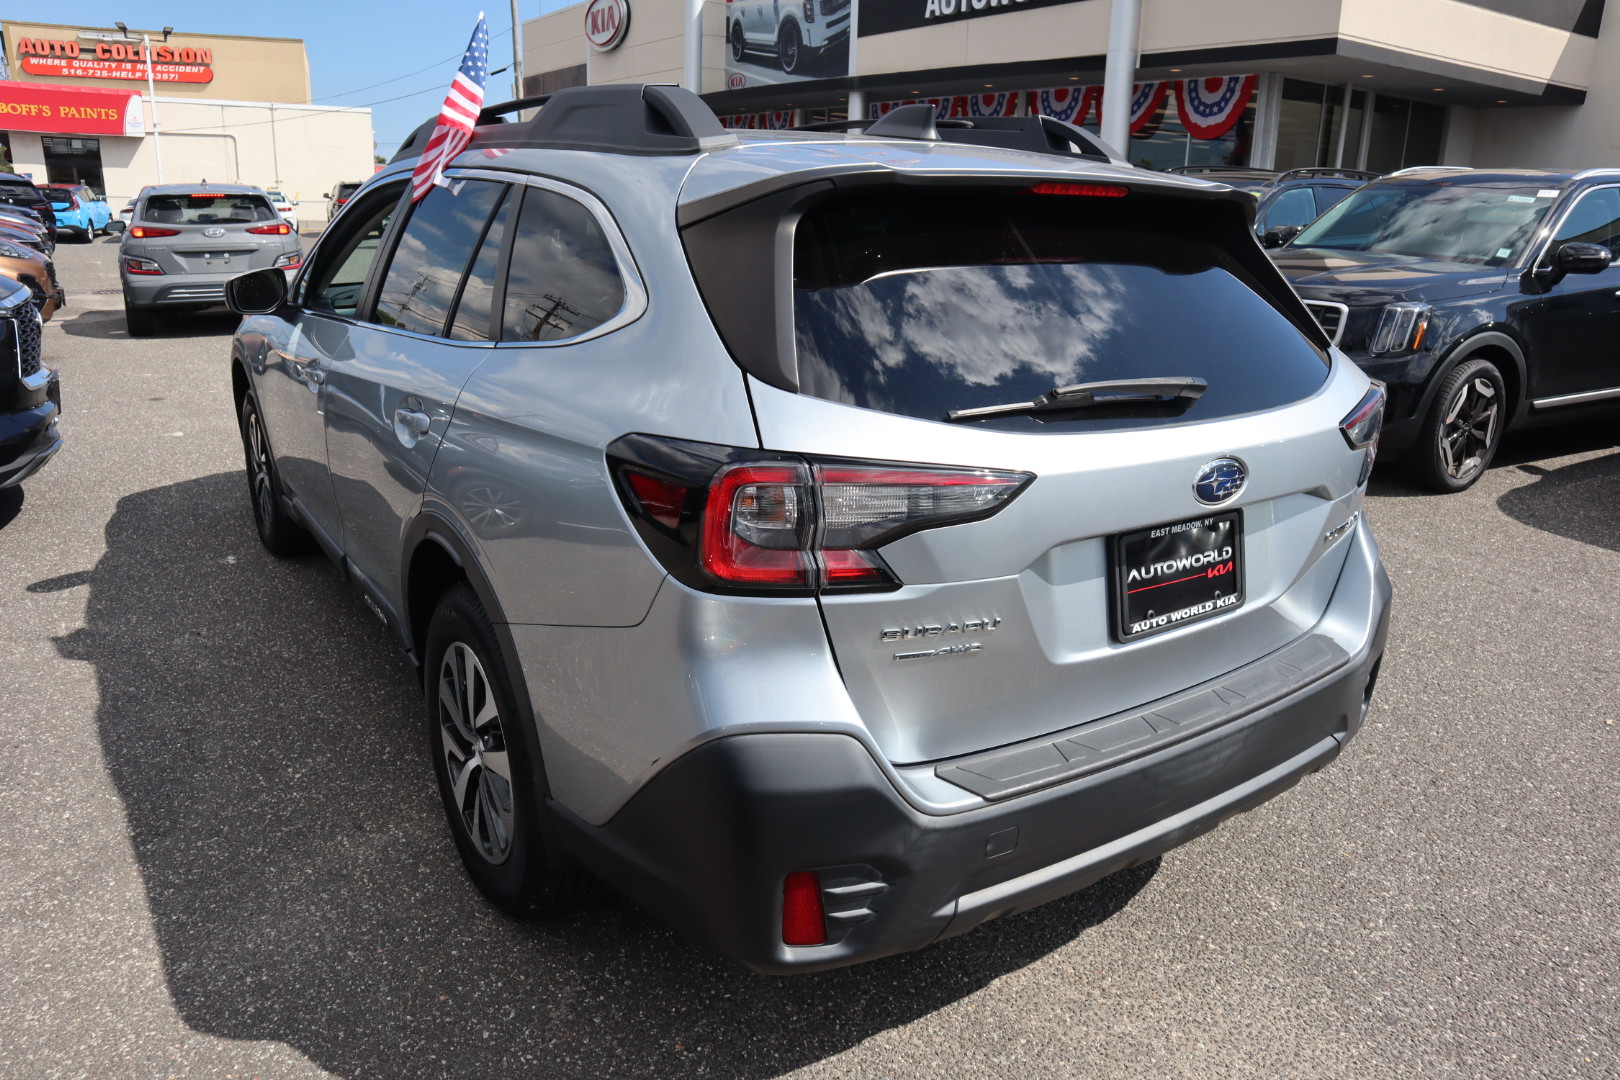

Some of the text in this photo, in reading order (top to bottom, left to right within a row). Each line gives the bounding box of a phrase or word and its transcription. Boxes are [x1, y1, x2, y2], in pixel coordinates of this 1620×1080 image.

[590, 5, 617, 36] KIA
[19, 37, 80, 58] AUTO
[30, 57, 67, 66] WHERE
[73, 60, 116, 69] QUALITY
[156, 65, 205, 73] ACCIDENT
[62, 68, 142, 79] 516-735-HELP
[0, 102, 118, 120] BOFF'S PAINTS
[1150, 527, 1170, 539] EAST
[1204, 518, 1214, 526] NY
[1127, 546, 1233, 584] AUTOWORLD
[1207, 561, 1233, 578] KIA
[1132, 595, 1237, 634] AUTO WORLD KIA
[880, 617, 1002, 642] SUBARU
